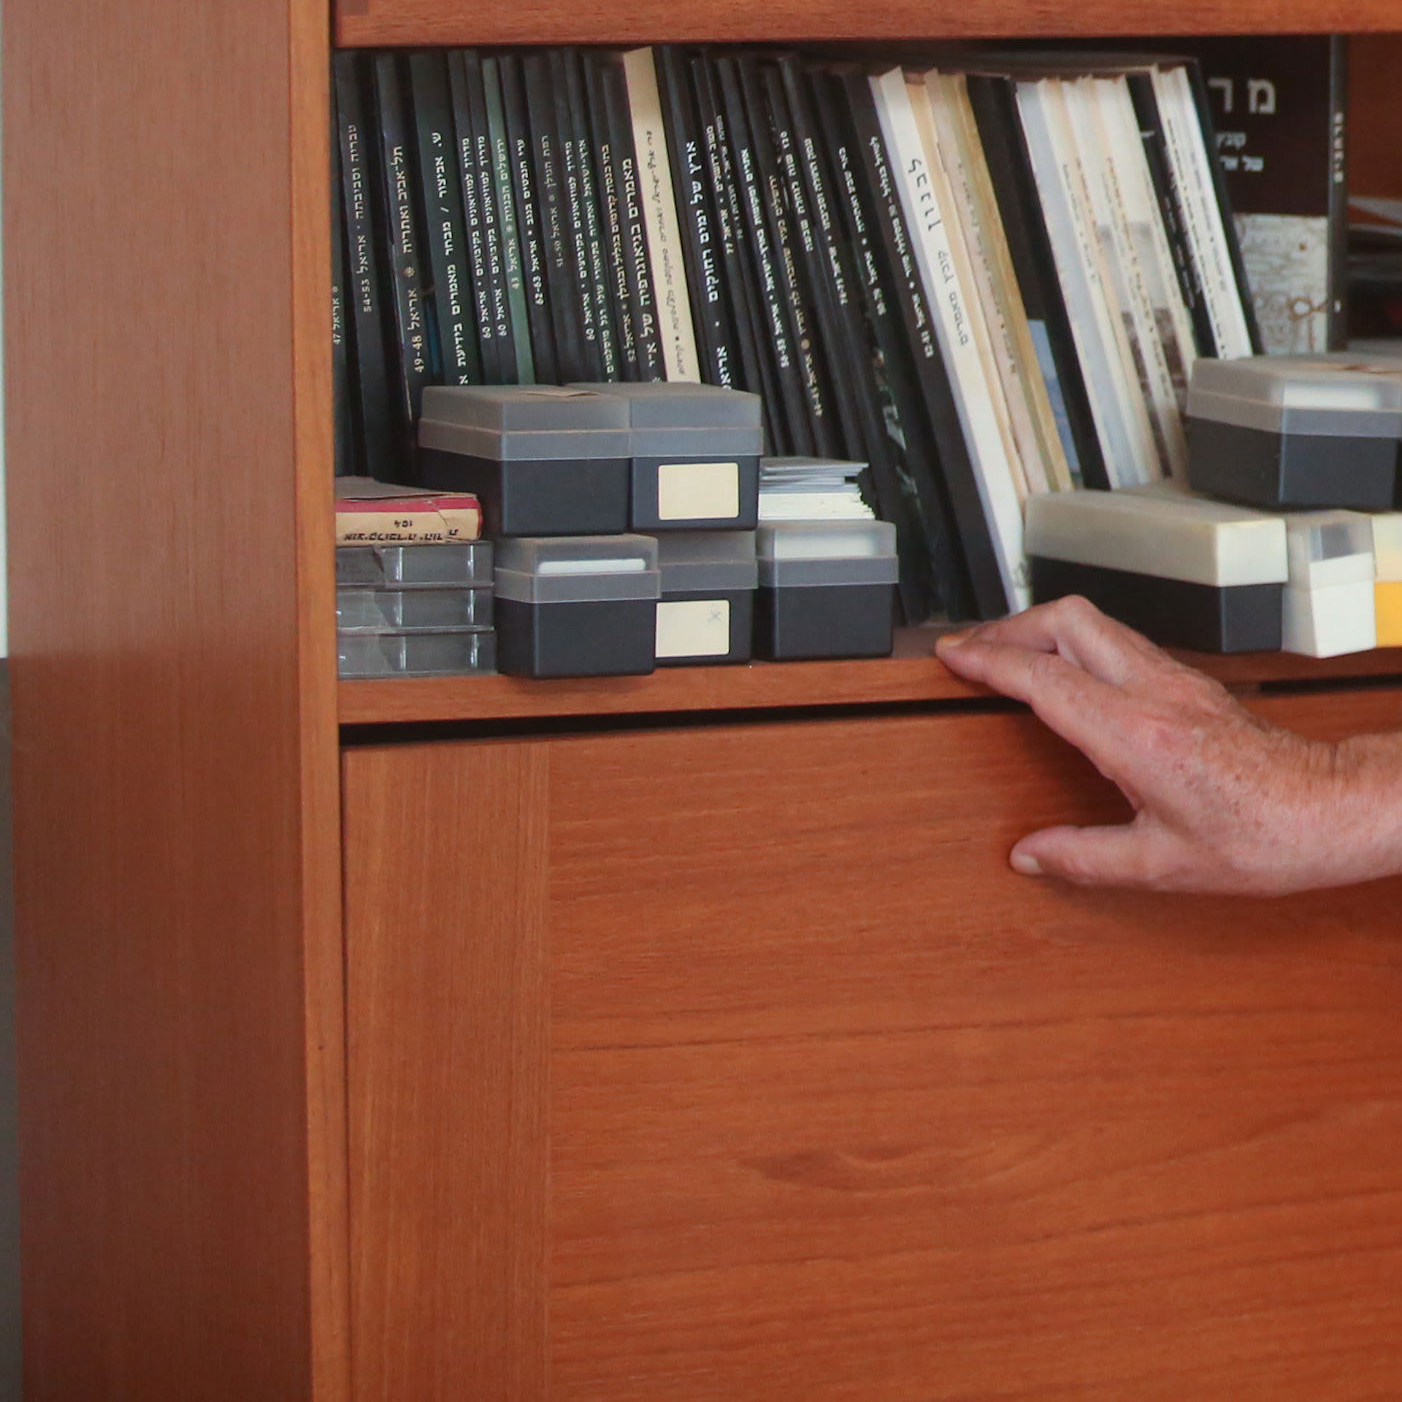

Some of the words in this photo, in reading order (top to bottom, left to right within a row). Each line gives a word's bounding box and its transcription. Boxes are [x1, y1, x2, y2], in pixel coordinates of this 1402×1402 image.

[348, 124, 358, 161] טבריה
[461, 137, 472, 167] מדריך
[477, 135, 487, 166] מדריך
[516, 138, 524, 156] ערי
[564, 141, 574, 171] מדריך
[601, 144, 609, 164] בתי
[685, 141, 701, 174] ארץ
[351, 167, 363, 219] וסביבתה
[434, 156, 446, 197] אביצור
[519, 160, 530, 198] הנבטים
[541, 135, 550, 156] רמת
[550, 207, 559, 238] אריאל
[603, 165, 614, 193] כנסת
[622, 158, 638, 218] מאמרים
[689, 180, 703, 204] של
[464, 173, 478, 225] למוזיאונים
[480, 171, 493, 223] למוזיאונים
[496, 138, 508, 180] ירושלים
[506, 238, 517, 271] אריאל
[524, 203, 533, 225] בנגב
[567, 176, 581, 228] למוזיאונים
[442, 221, 452, 255] מבחר
[695, 209, 709, 243] ימים
[356, 235, 368, 273] אריאל
[471, 230, 483, 276] בקיבוצים
[487, 228, 499, 274] בקיבוצים
[529, 240, 539, 271] אריאל
[575, 233, 587, 278] בקיבוצים
[611, 234, 622, 265] בגליל
[630, 224, 649, 305] בגיאוגרפיה
[908, 158, 941, 230] לבנון
[948, 292, 968, 345] מאמרים
[399, 205, 411, 252] ואתריה
[407, 289, 419, 330] אריאל
[702, 249, 718, 302] רחוקים
[447, 264, 460, 315] מאמרים
[478, 290, 488, 322] אריאל
[494, 288, 504, 319] אריאל
[330, 298, 340, 329] אריאל
[582, 292, 592, 324] אריאל
[639, 313, 653, 337] של
[771, 303, 782, 335] אריאל
[332, 333, 341, 344] 47
[453, 323, 466, 366] בידיעת
[482, 326, 491, 338] 60
[497, 323, 507, 336] 60
[585, 328, 595, 340] 60
[622, 314, 633, 348] אריאל
